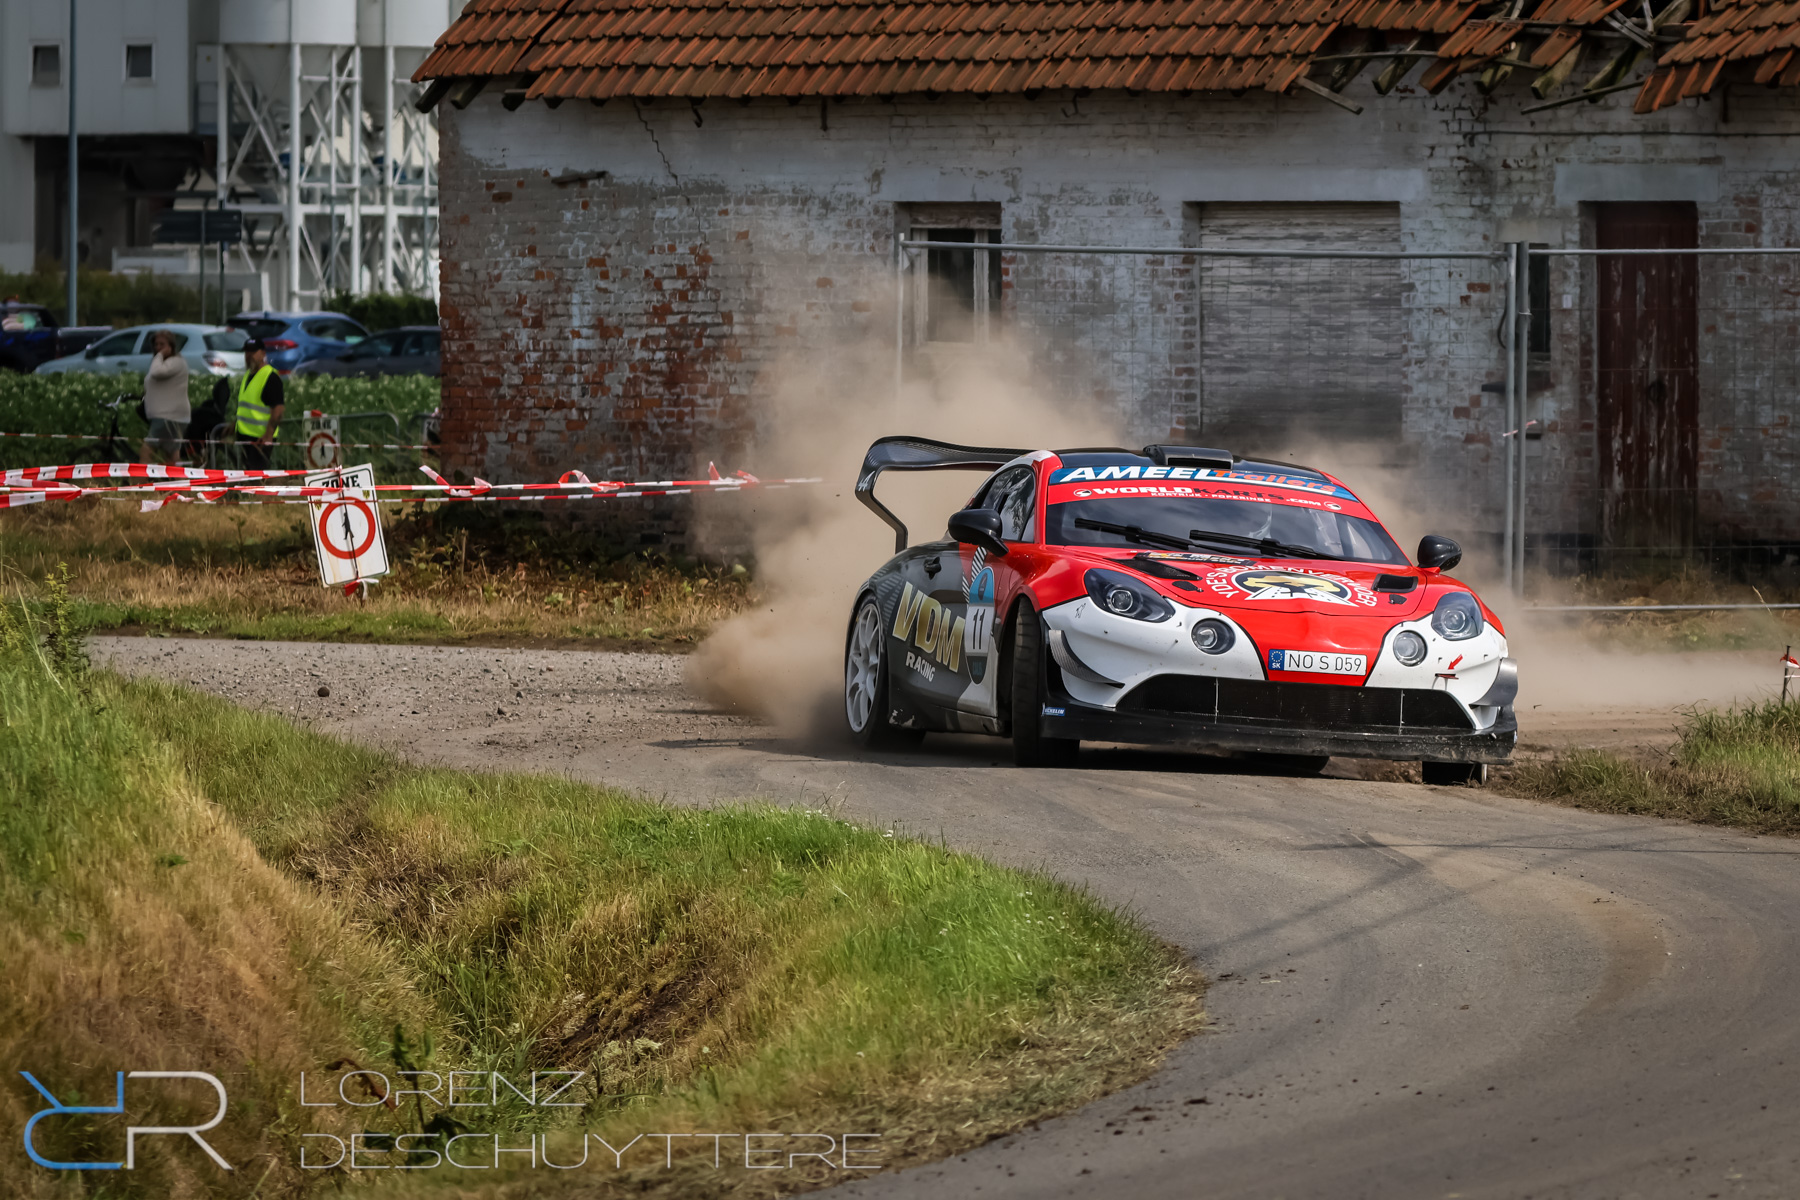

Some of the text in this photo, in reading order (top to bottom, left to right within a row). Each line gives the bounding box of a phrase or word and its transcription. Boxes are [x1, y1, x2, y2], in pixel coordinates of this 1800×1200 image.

[1060, 466, 1338, 493] AMEEL Trailers
[1211, 494, 1272, 503] POPERINGE
[1206, 565, 1378, 607] YDE'S BOMENVERVOER
[892, 581, 966, 673] VDM
[973, 608, 986, 650] 11
[905, 651, 936, 682] RACING
[1288, 653, 1362, 672] NO S 059
